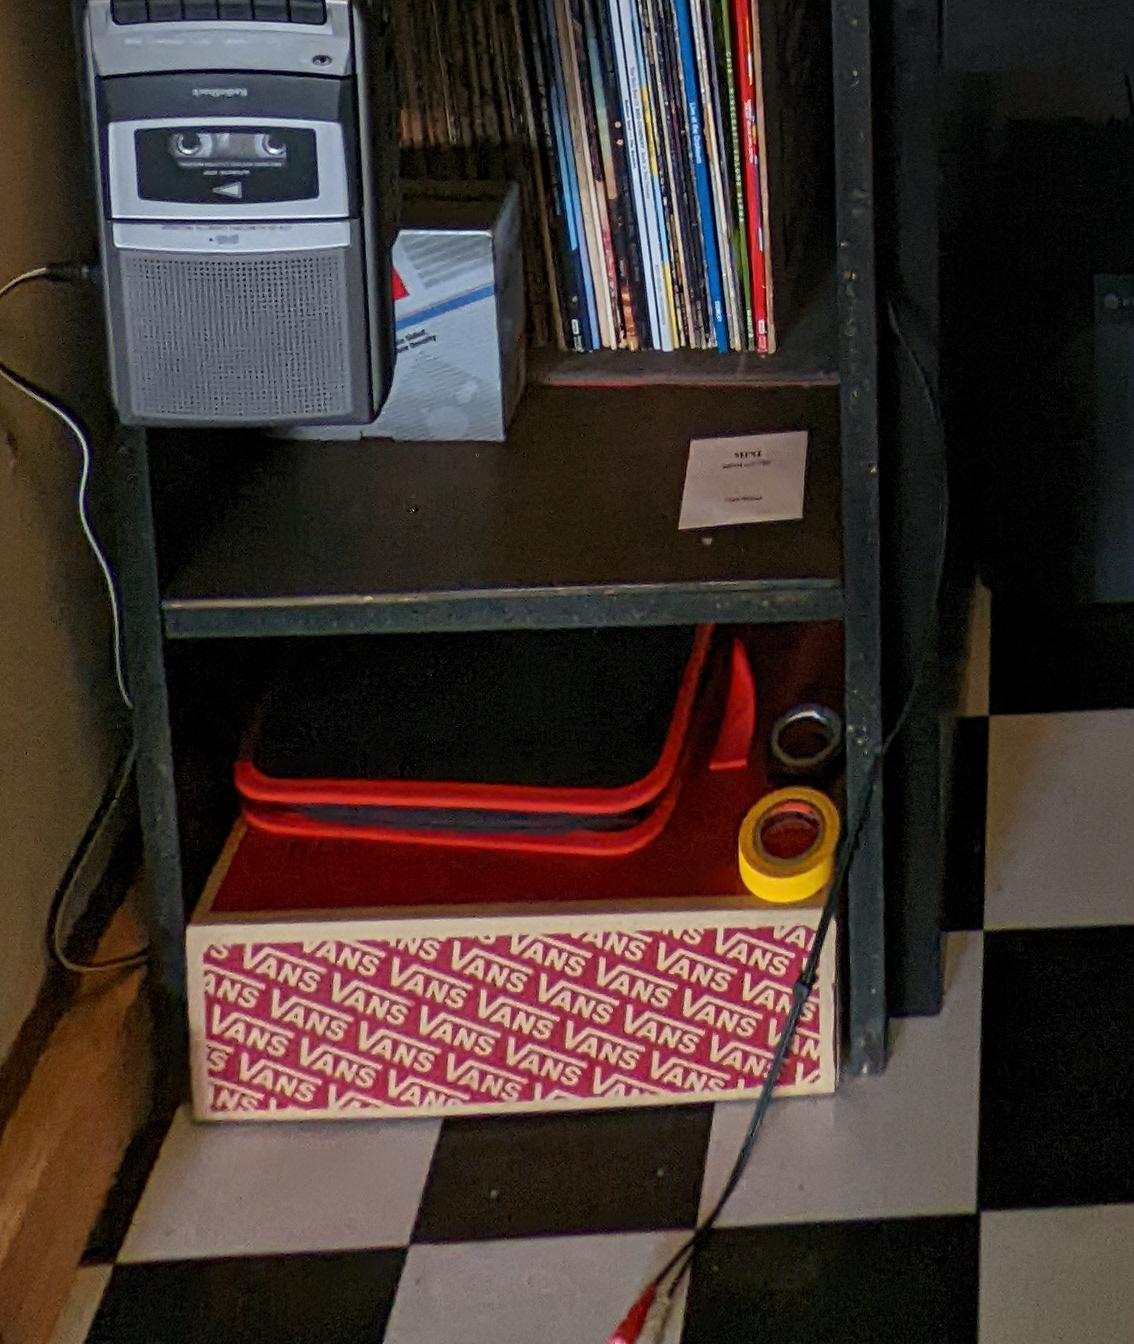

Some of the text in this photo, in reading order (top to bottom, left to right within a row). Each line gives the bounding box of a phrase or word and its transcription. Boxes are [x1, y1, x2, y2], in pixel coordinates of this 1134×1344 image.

[391, 956, 473, 1009] VANS
[451, 940, 533, 992] VANS
[597, 956, 678, 1009] VANS
[657, 941, 738, 993] VANS
[272, 988, 353, 1041] VANS
[332, 971, 415, 1025] VANS
[479, 989, 560, 1040] VANS
[539, 972, 620, 1025] VANS
[683, 988, 763, 1038] VANS
[212, 1004, 294, 1057] VANS
[359, 1021, 441, 1073] VANS
[420, 1004, 501, 1057] VANS
[565, 1020, 646, 1071] VANS
[624, 1004, 705, 1054] VANS
[240, 1052, 322, 1103] VANS
[300, 1037, 382, 1089] VANS
[447, 1053, 528, 1101] VANS
[507, 1037, 588, 1087] VANS
